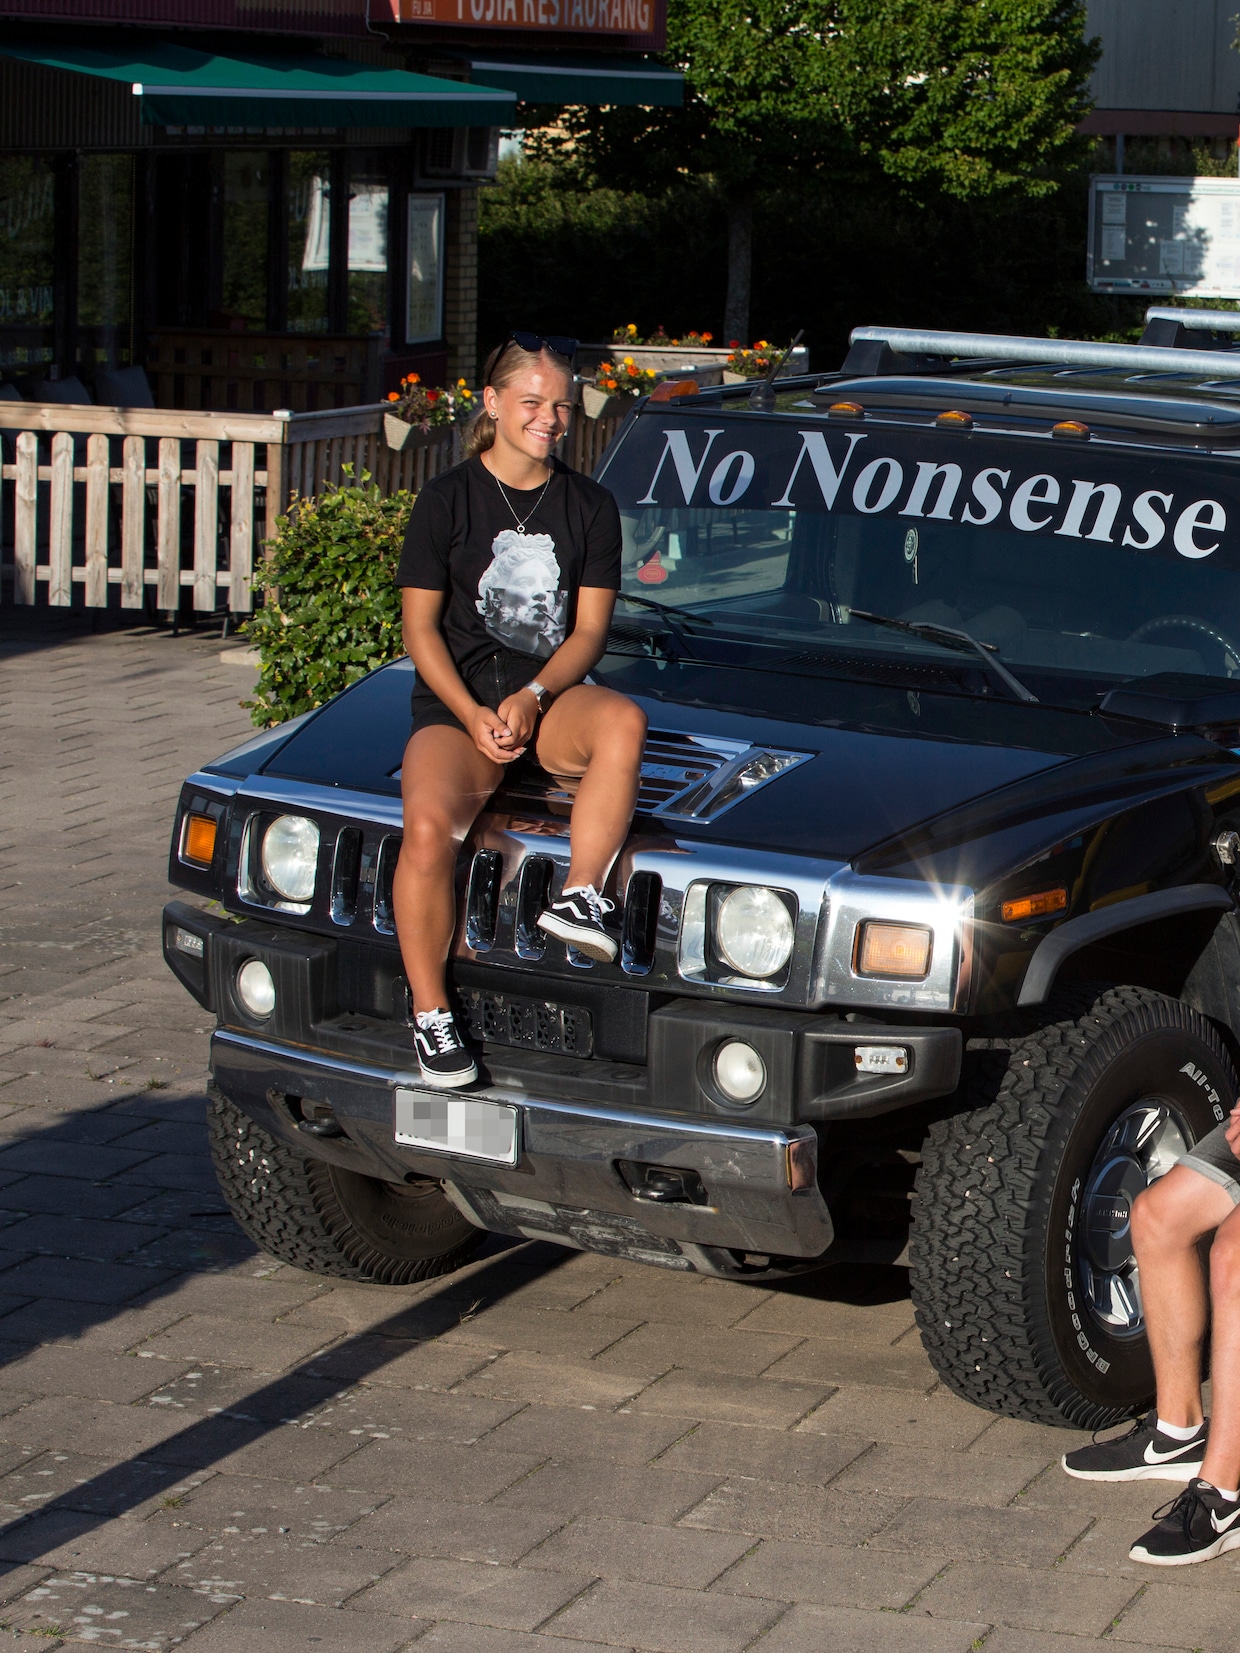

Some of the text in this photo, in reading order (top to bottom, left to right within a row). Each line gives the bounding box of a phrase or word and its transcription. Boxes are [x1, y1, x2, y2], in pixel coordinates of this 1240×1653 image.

[637, 429, 1228, 560] No Nonsense
[1064, 1177, 1111, 1375] BFGoodrich
